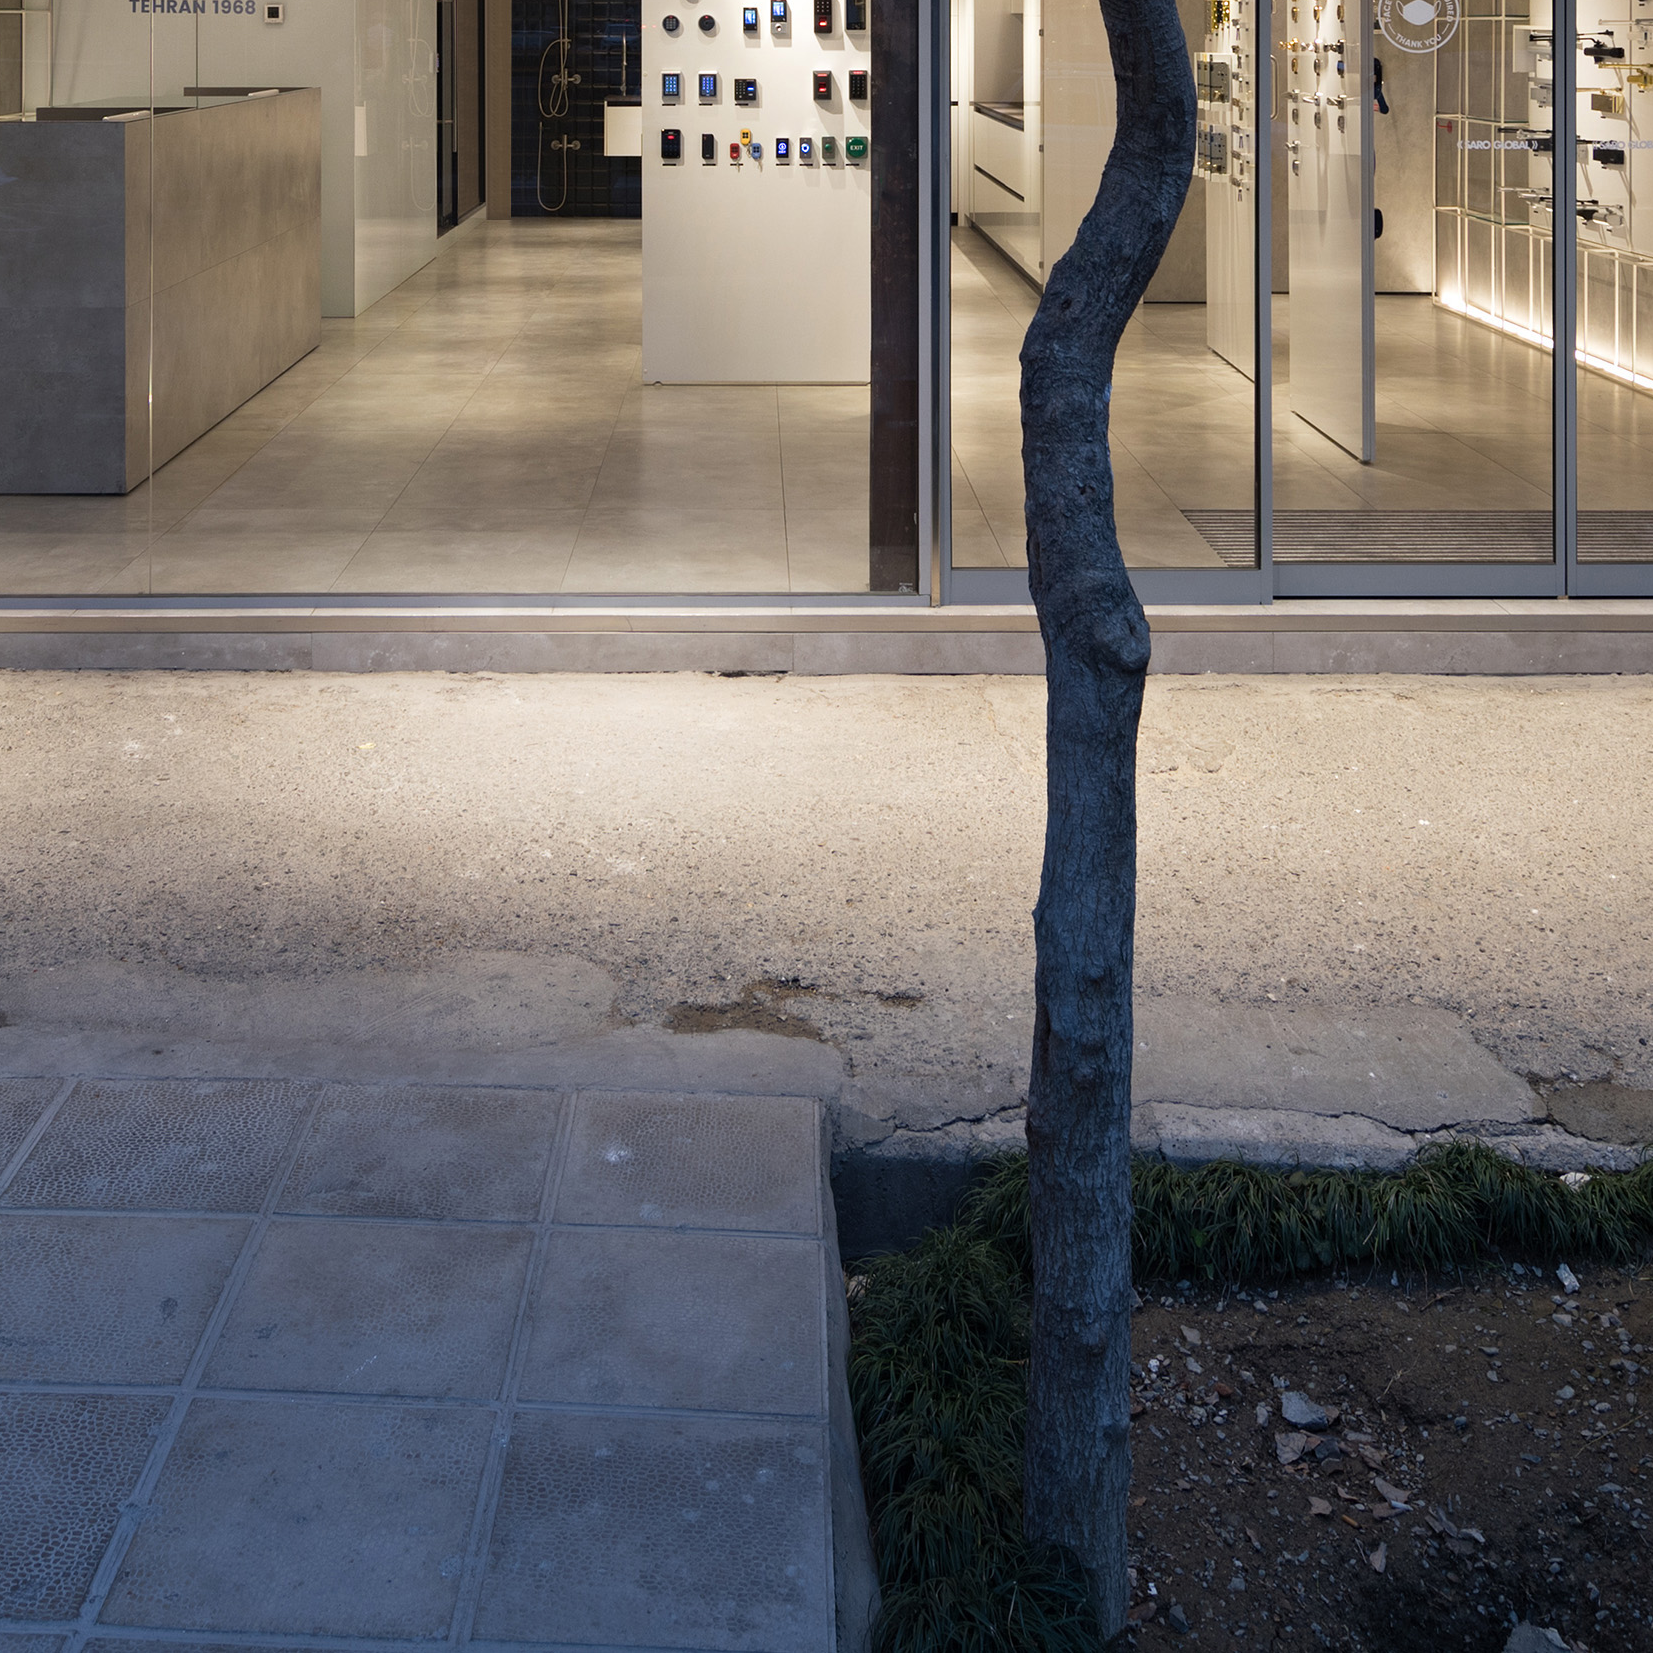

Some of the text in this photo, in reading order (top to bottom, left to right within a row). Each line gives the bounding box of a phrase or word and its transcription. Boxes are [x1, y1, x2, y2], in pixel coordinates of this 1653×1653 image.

[129, 0, 256, 15] TEHRAN 1968
[1383, 0, 1393, 23] FACE
[1395, 33, 1443, 48] THANK YOU
[1465, 140, 1530, 150] SARO GLOBAL
